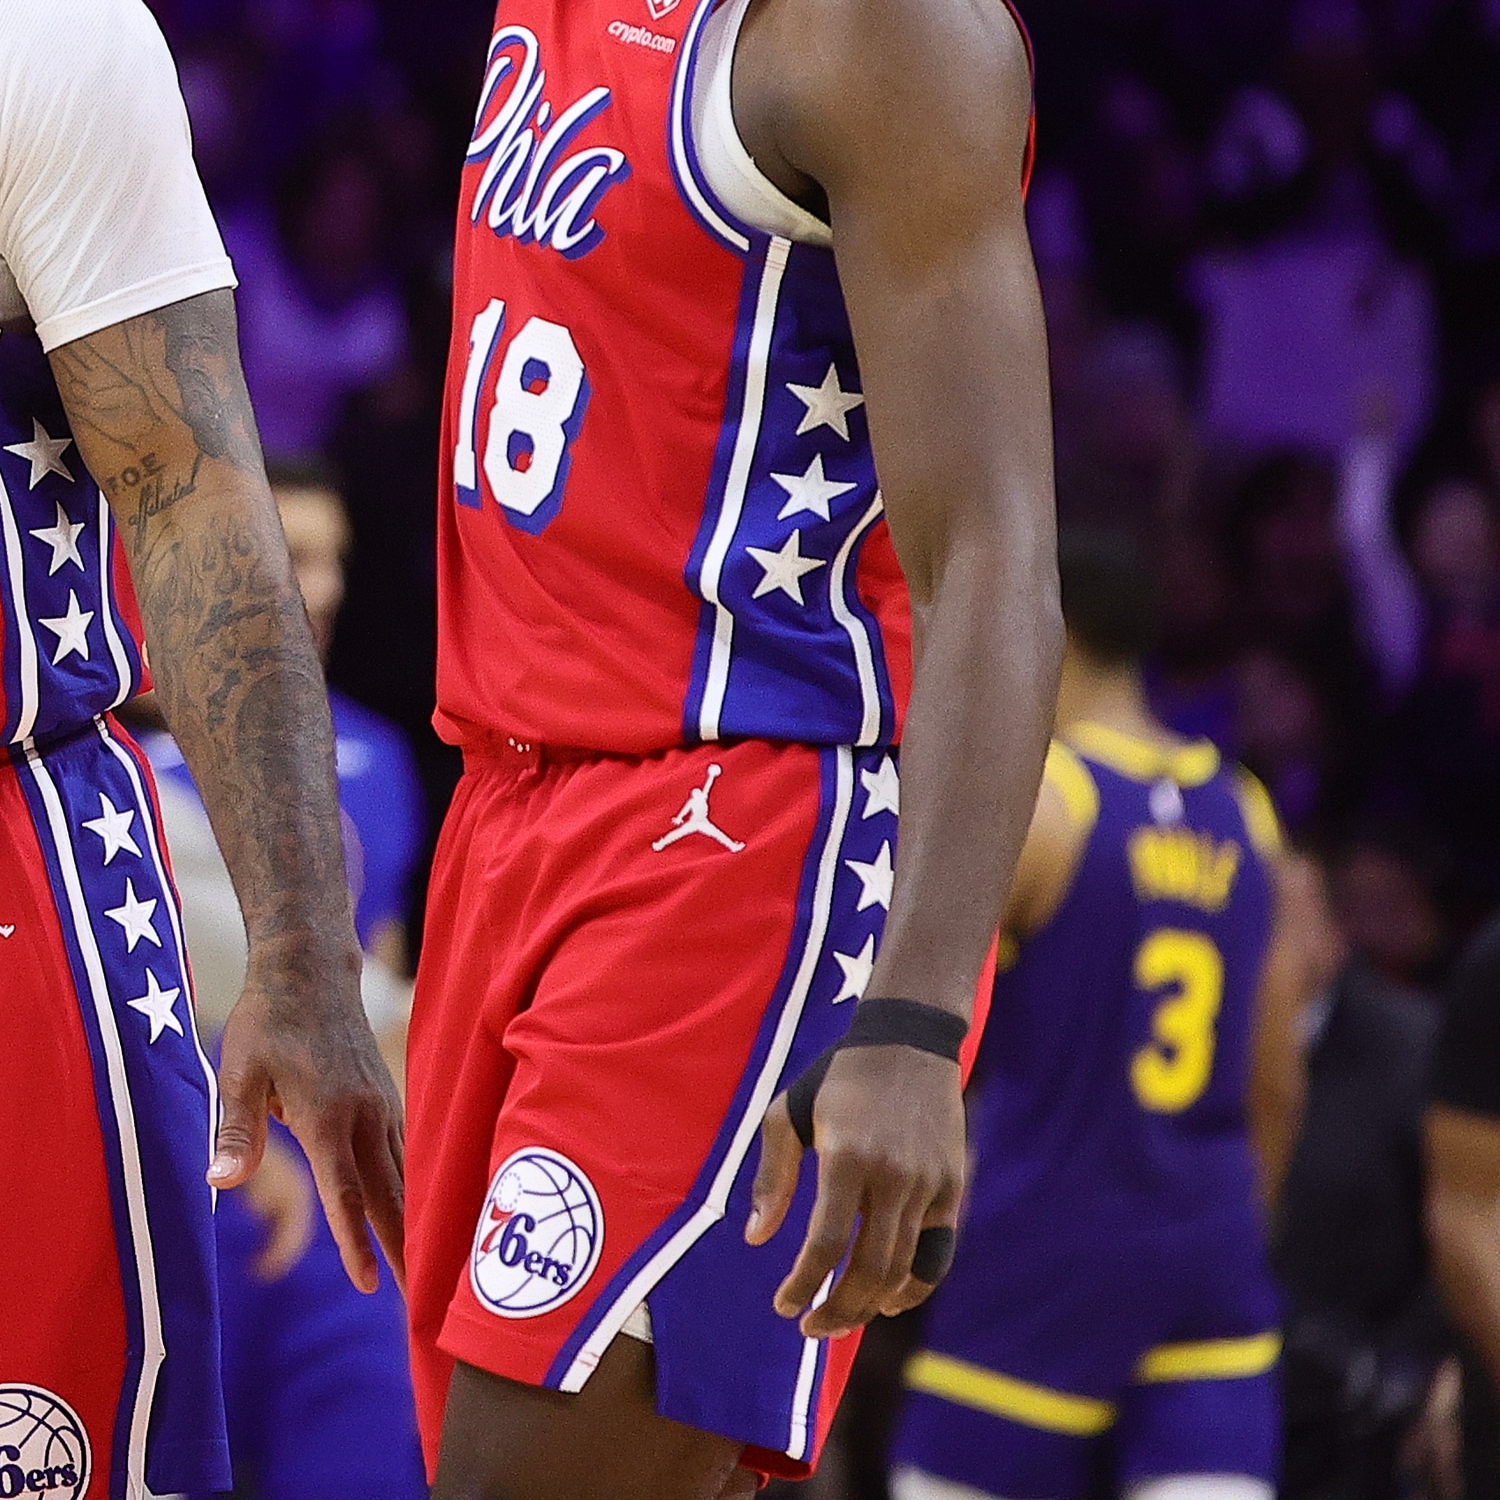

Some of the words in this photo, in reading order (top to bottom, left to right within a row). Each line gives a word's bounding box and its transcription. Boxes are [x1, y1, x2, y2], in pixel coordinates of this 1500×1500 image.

[607, 20, 677, 55] crypto.com
[466, 25, 628, 255] Phila
[453, 297, 589, 530] 18
[1130, 927, 1226, 1116] 3
[479, 1197, 573, 1287] 76ers
